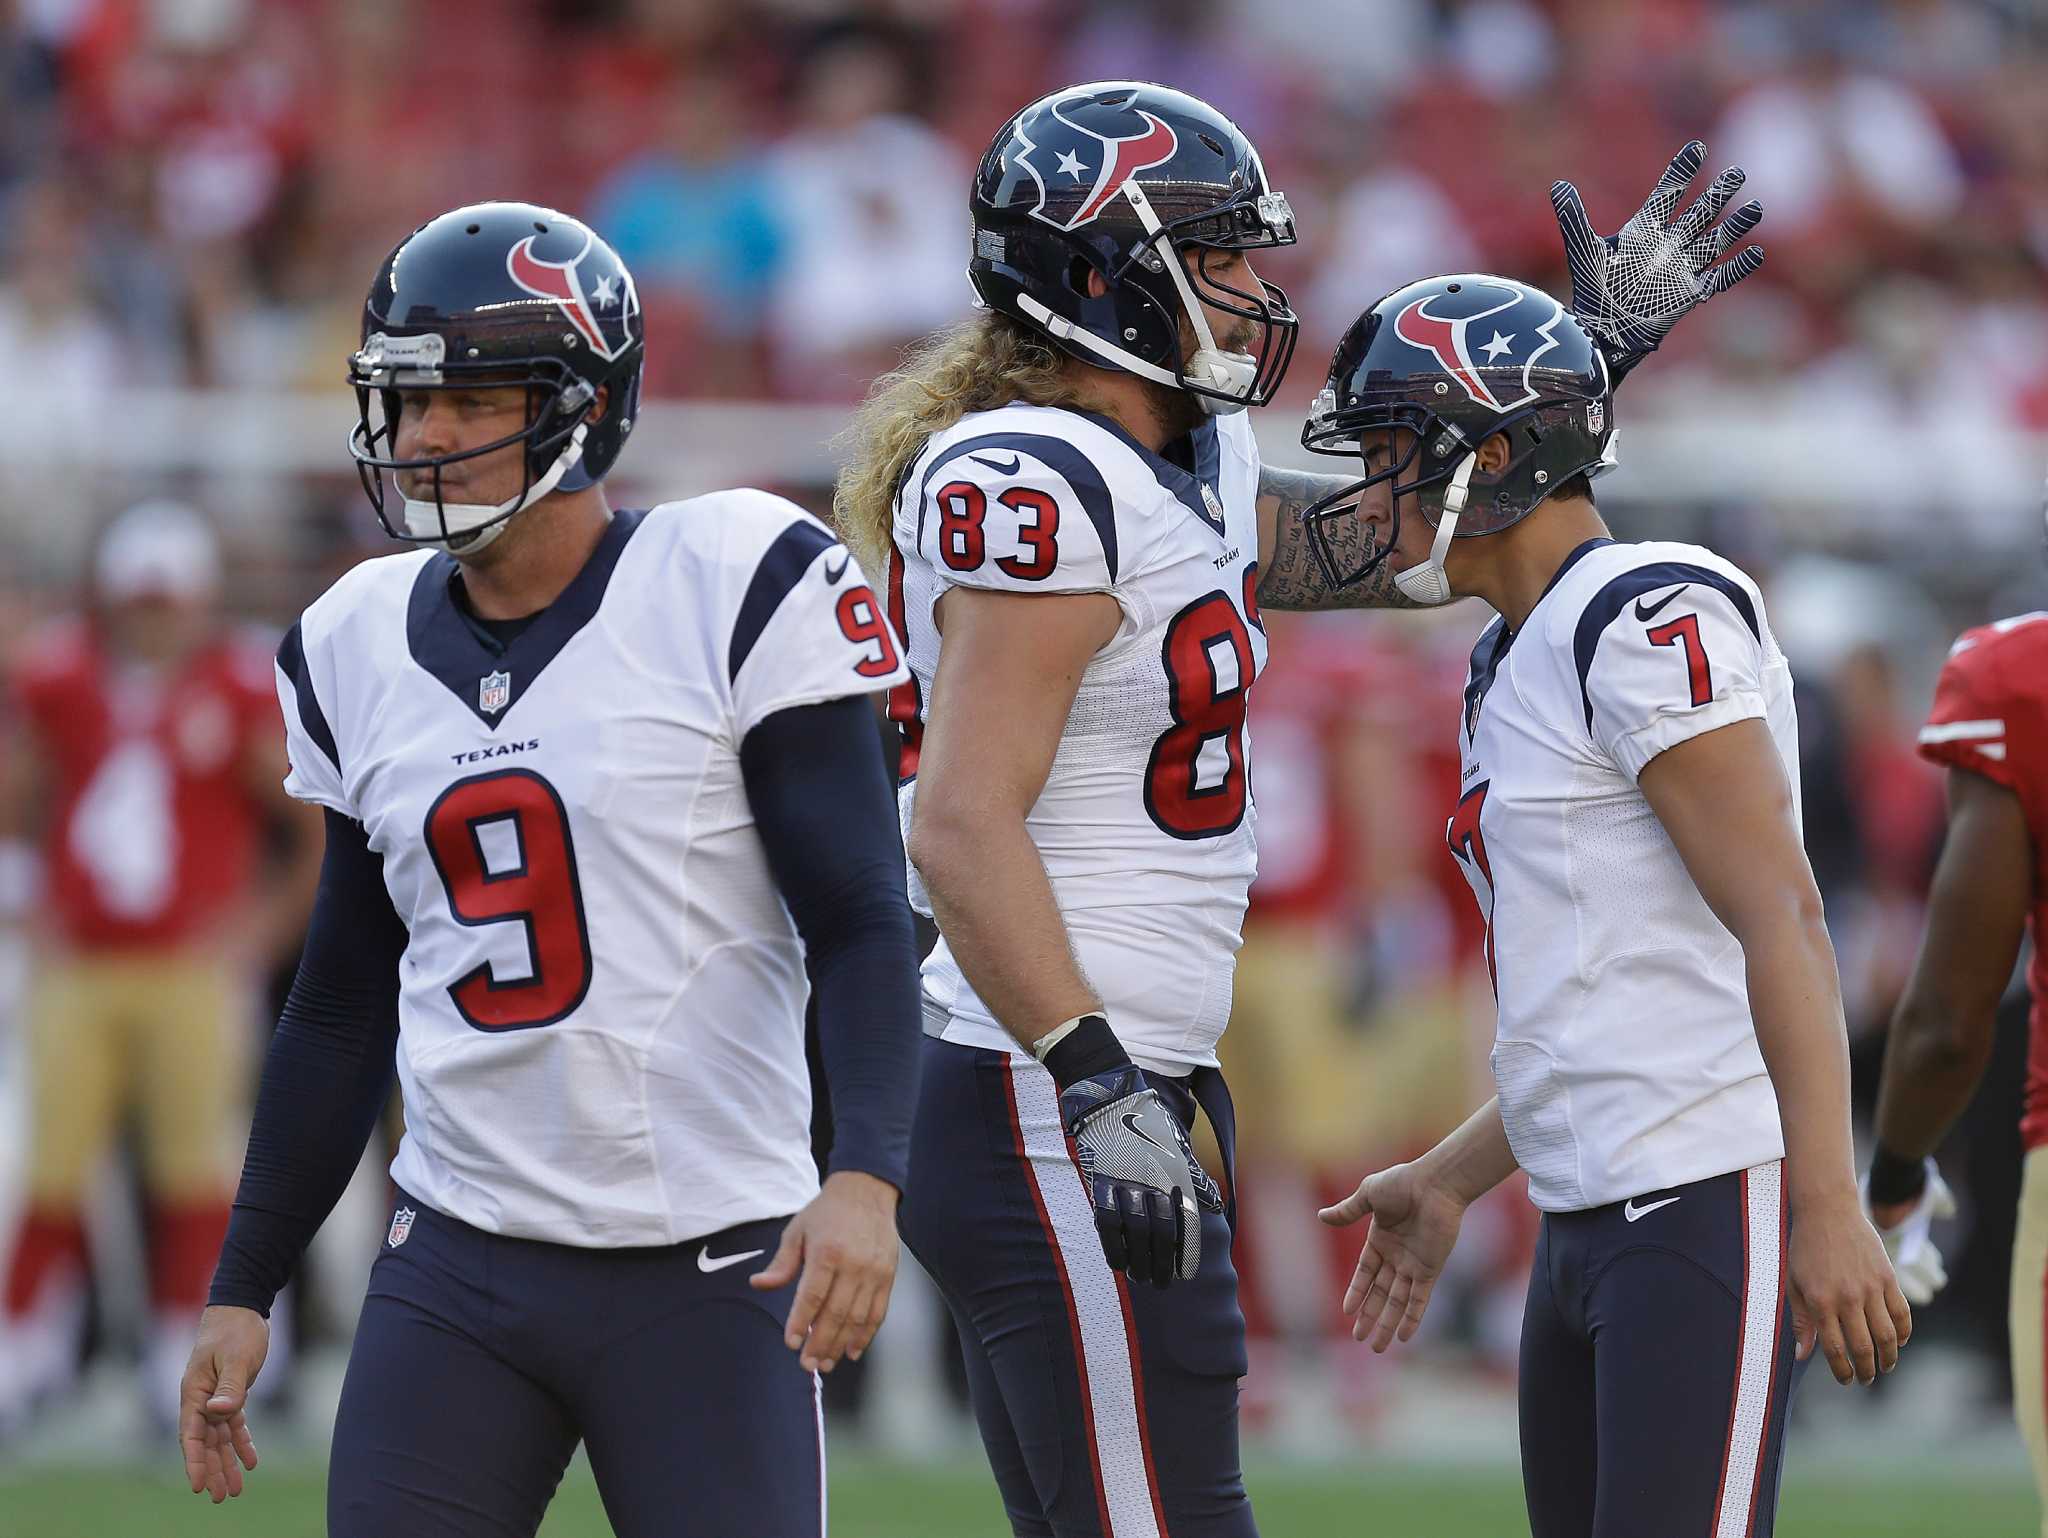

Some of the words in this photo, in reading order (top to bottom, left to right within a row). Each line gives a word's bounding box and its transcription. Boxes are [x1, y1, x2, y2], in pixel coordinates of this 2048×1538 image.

[936, 480, 1060, 582] 83
[1213, 547, 1240, 571] TEXANS
[835, 585, 899, 677] 9
[1646, 612, 1713, 708] 7
[1143, 561, 1266, 841] 8
[451, 738, 539, 765] TEXANS
[1462, 761, 1480, 784] TEXANS
[423, 767, 593, 1033] 9
